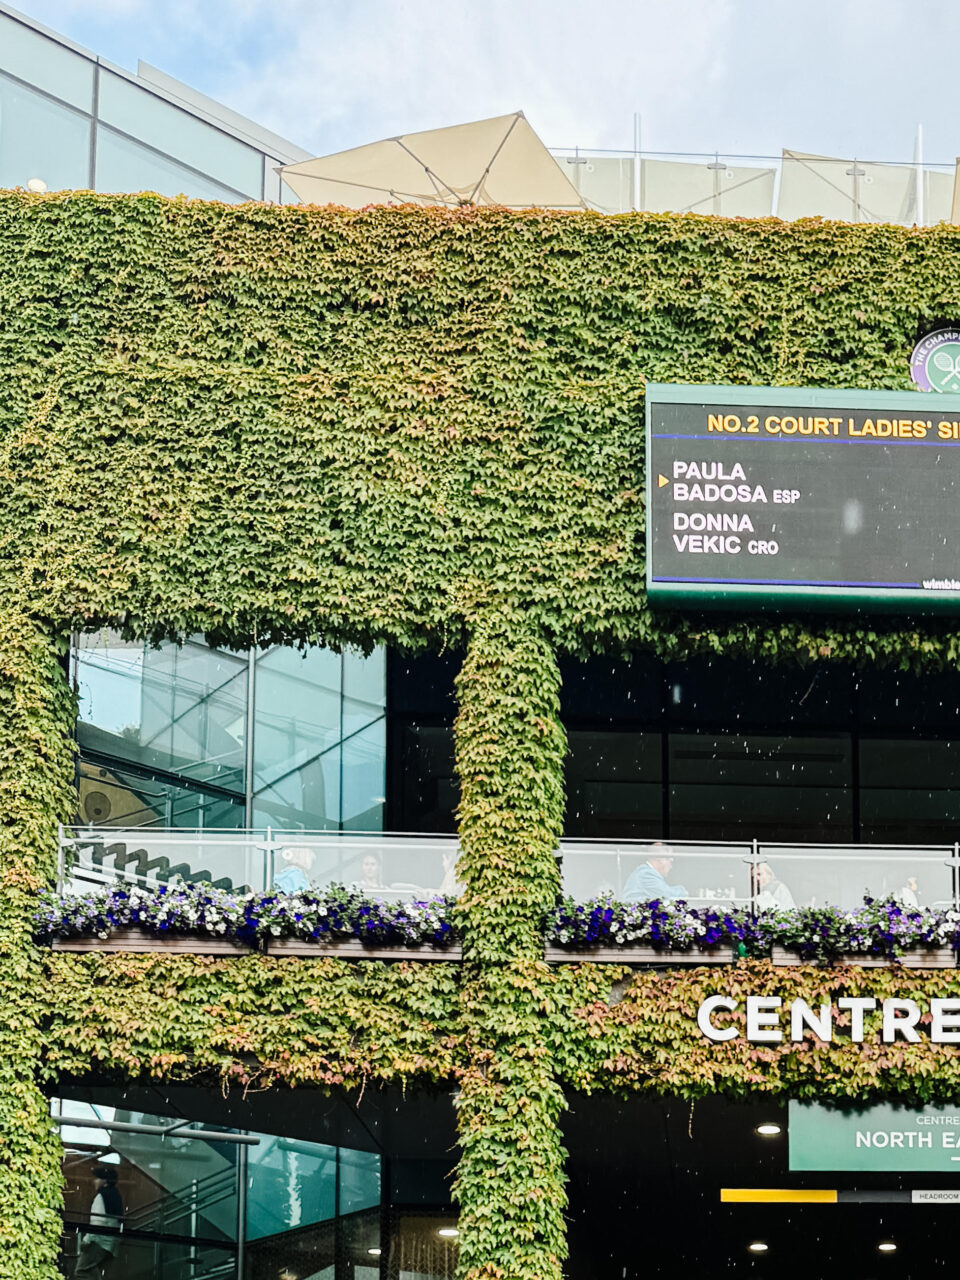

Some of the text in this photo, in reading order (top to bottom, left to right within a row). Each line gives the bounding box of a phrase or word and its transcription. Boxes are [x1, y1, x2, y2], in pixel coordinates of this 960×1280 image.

[915, 347, 928, 366] THE
[707, 414, 759, 433] NO.2
[764, 416, 842, 435] COURT
[848, 418, 932, 438] LADIES'
[673, 461, 746, 480] PAULA
[673, 484, 800, 504] BADOSA ESP
[673, 512, 754, 532] DONNA
[673, 535, 779, 555] VEKIC CRO
[916, 1116, 960, 1125] CENTRE
[855, 1131, 933, 1149] NORTH
